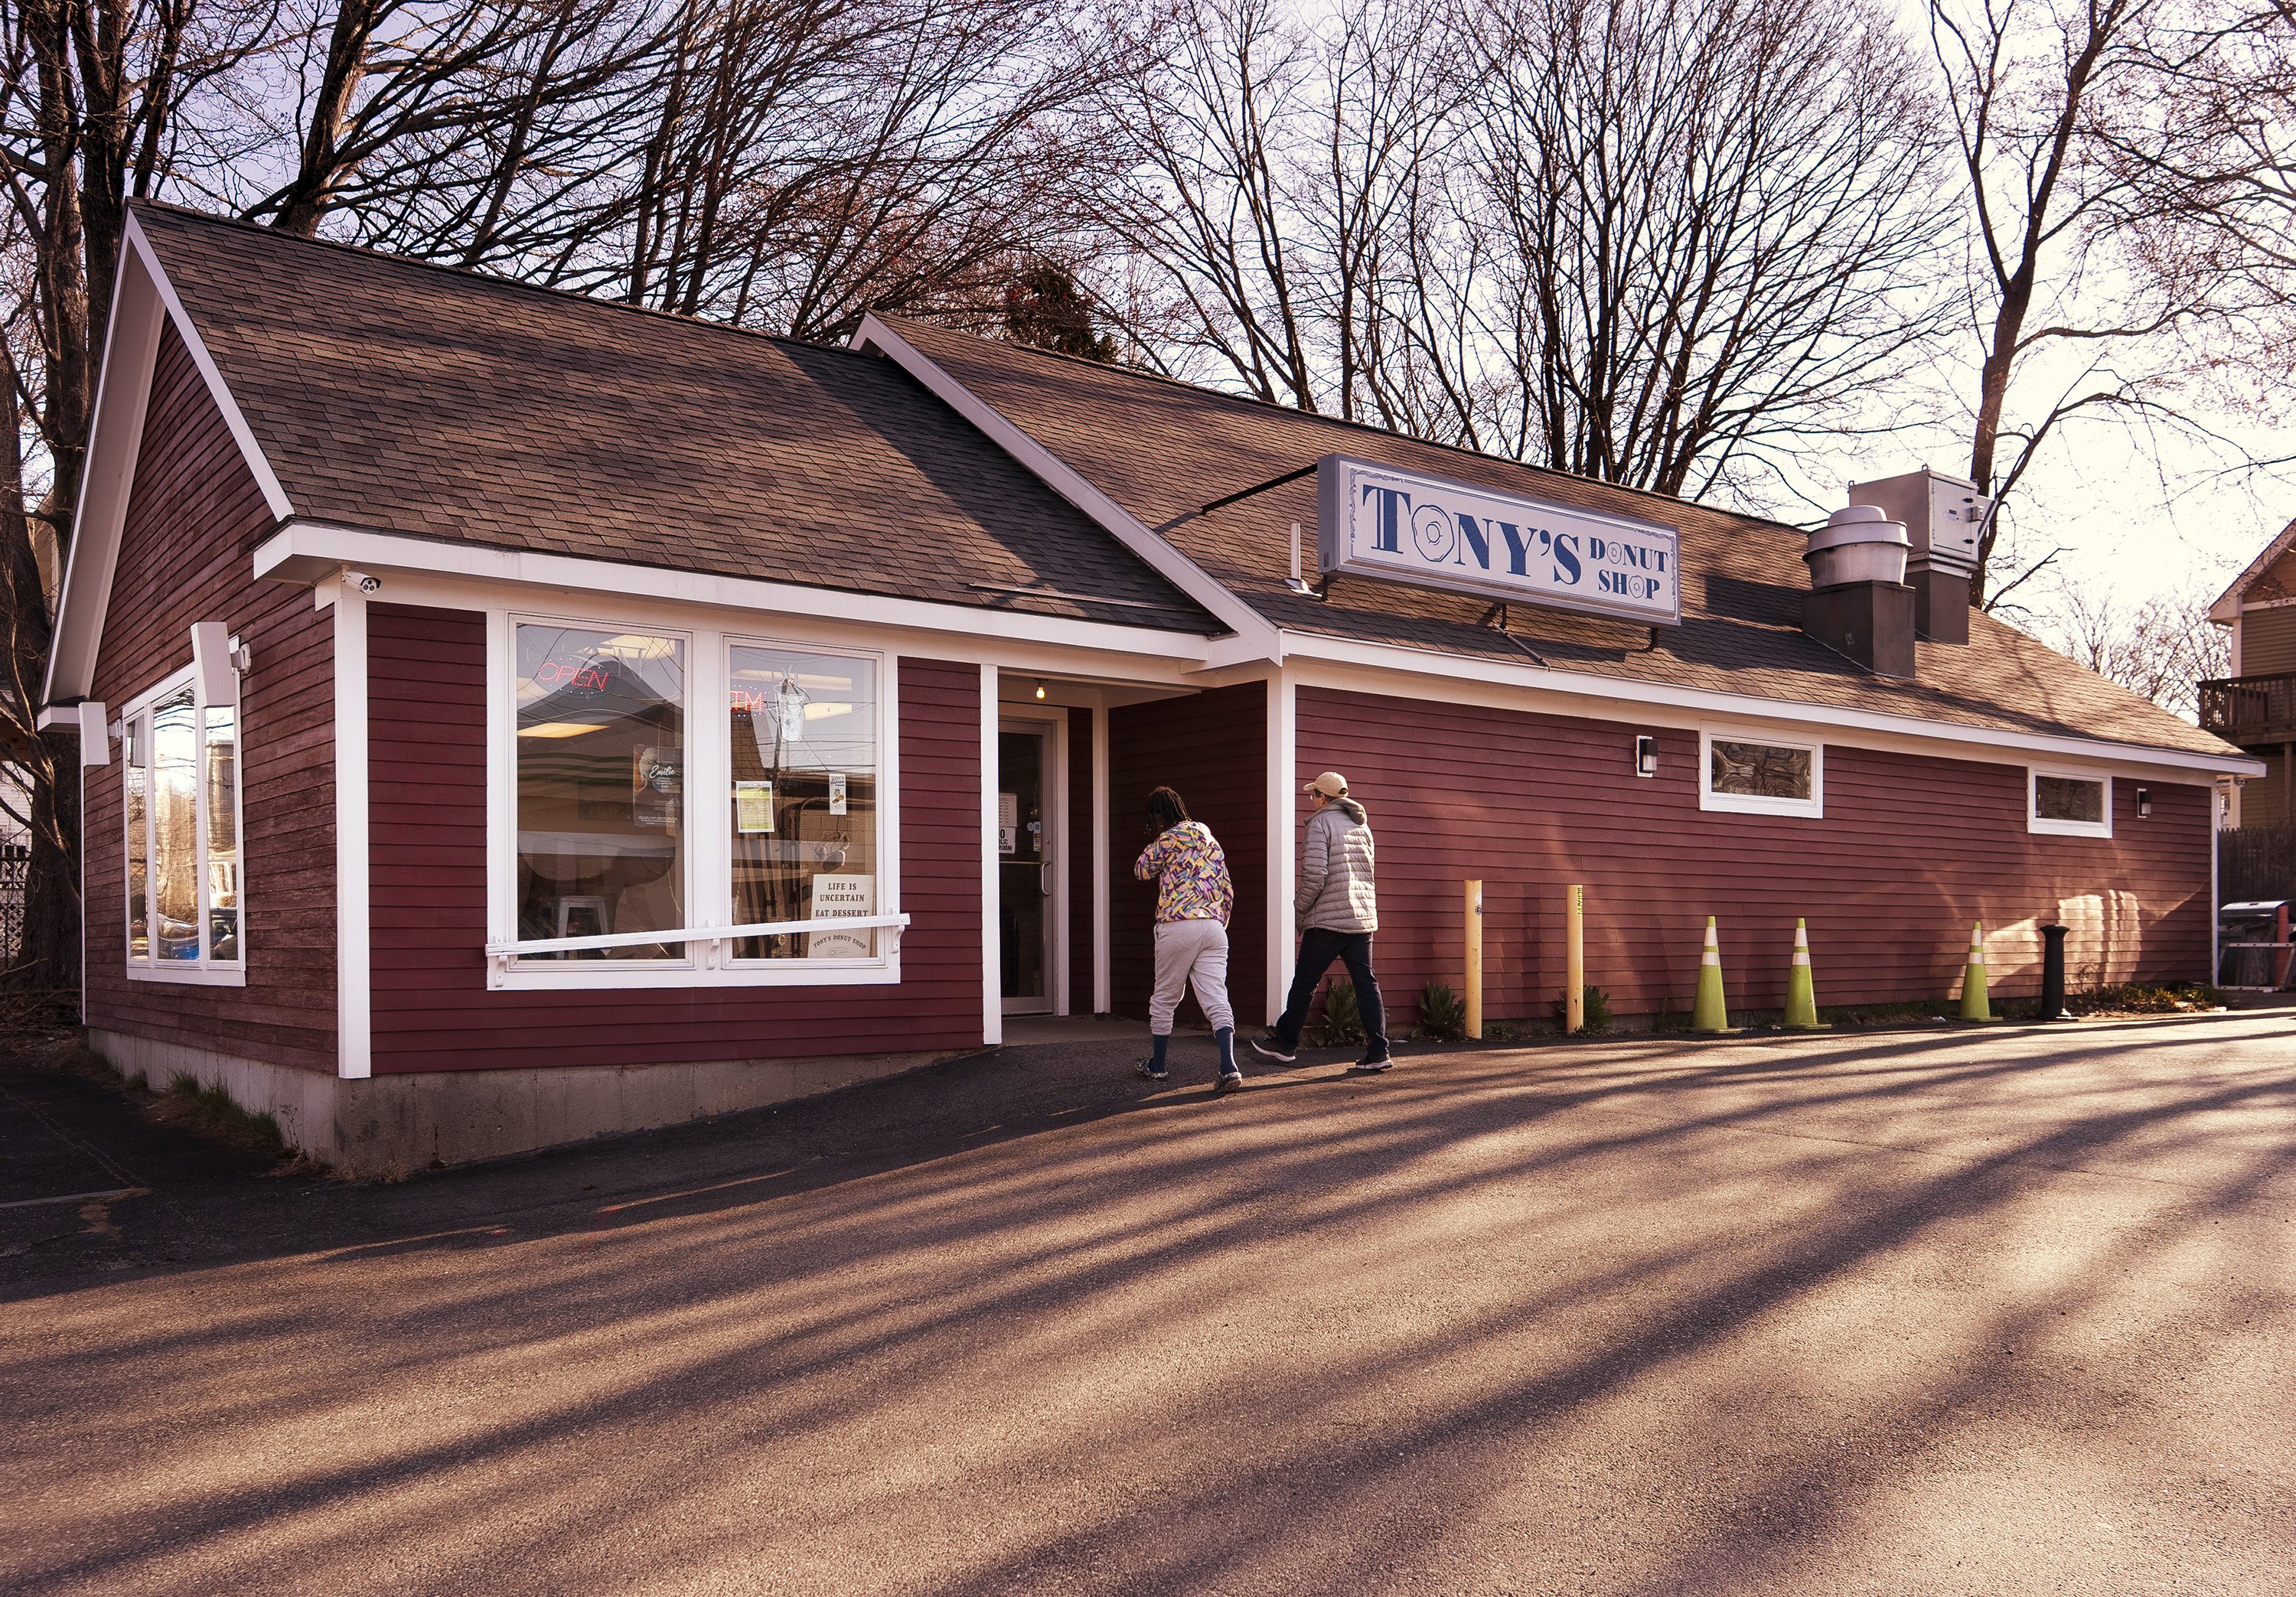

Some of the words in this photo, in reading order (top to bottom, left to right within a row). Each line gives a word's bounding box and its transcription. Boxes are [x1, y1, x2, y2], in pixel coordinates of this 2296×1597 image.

[1362, 484, 1582, 585] TONY'S
[1589, 536, 1668, 573] DONUT
[1598, 569, 1660, 601] SHOP
[538, 662, 609, 690] OPEN
[729, 690, 763, 713] TM
[649, 764, 677, 779] Emilie
[813, 935, 832, 949] TONY'S
[852, 938, 866, 950] SHOP
